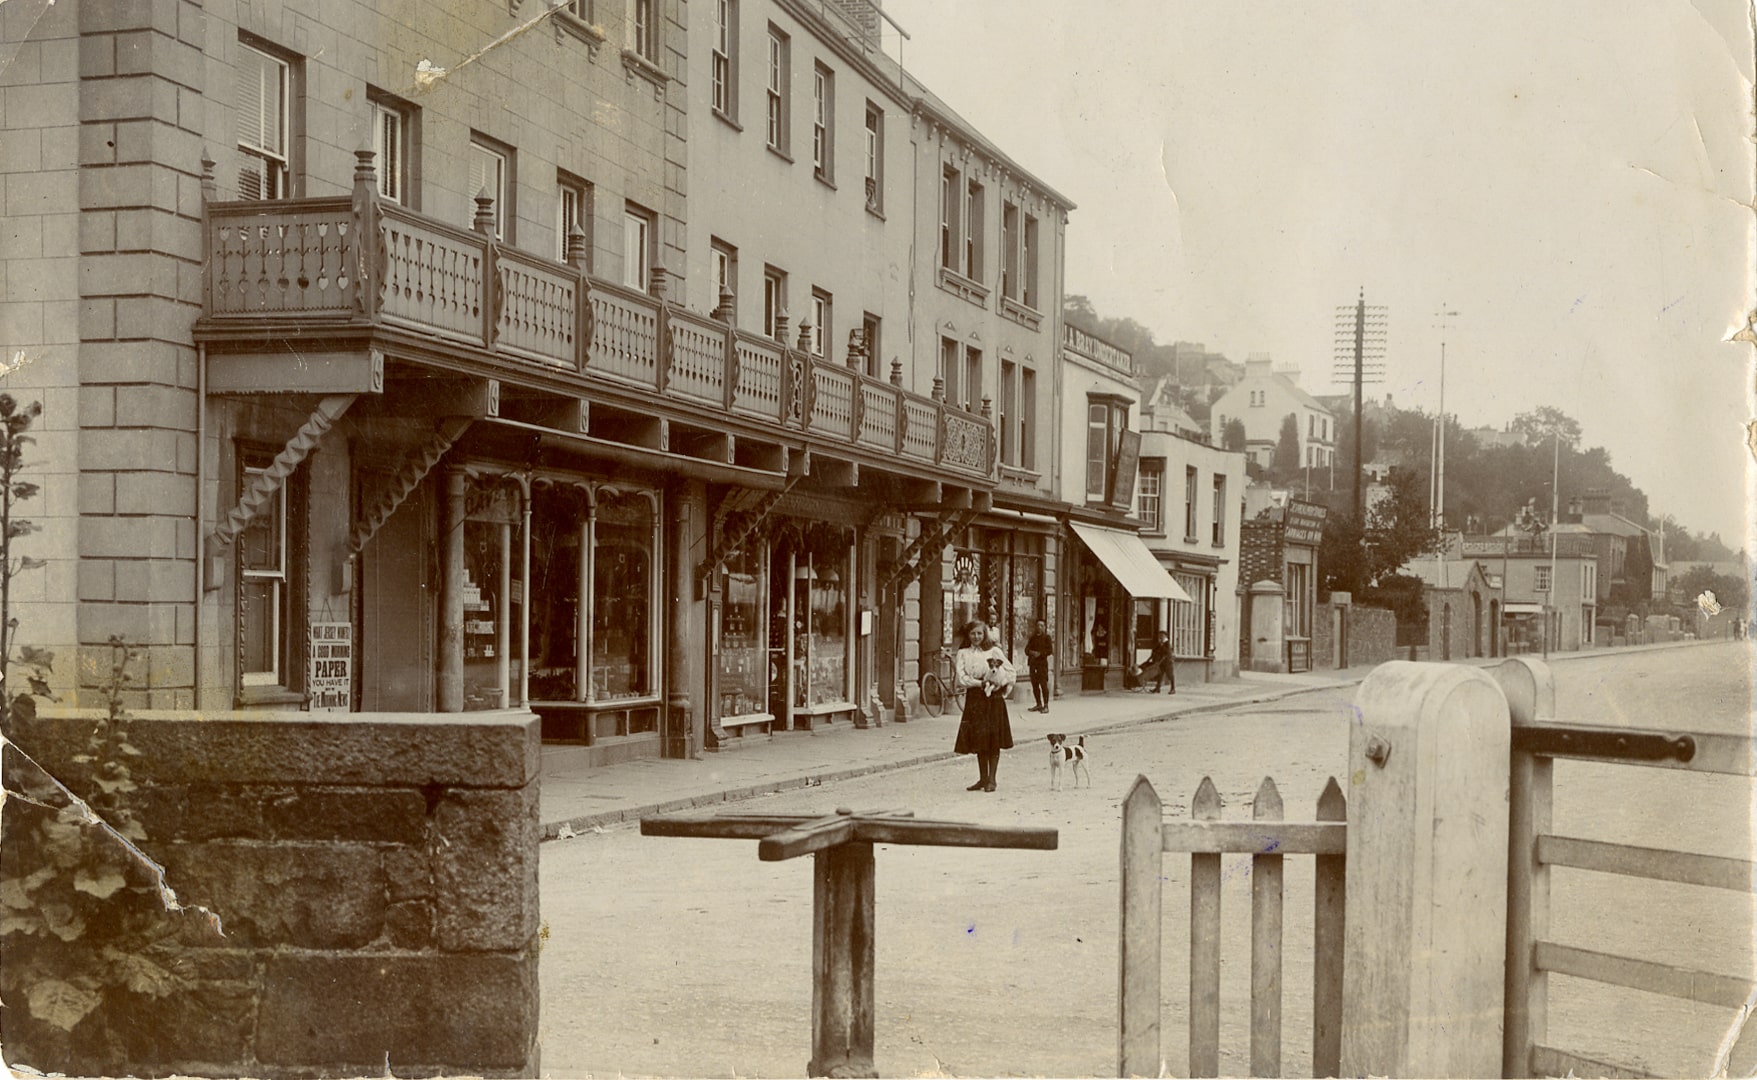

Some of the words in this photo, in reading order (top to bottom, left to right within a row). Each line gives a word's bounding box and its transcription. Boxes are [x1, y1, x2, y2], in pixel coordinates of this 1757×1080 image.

[1076, 330, 1093, 355] BRAY
[318, 645, 329, 658] GOOD
[315, 661, 347, 678] PAPER
[312, 679, 325, 687] YOU
[326, 678, 343, 687] HAVE
[343, 678, 349, 686] IT
